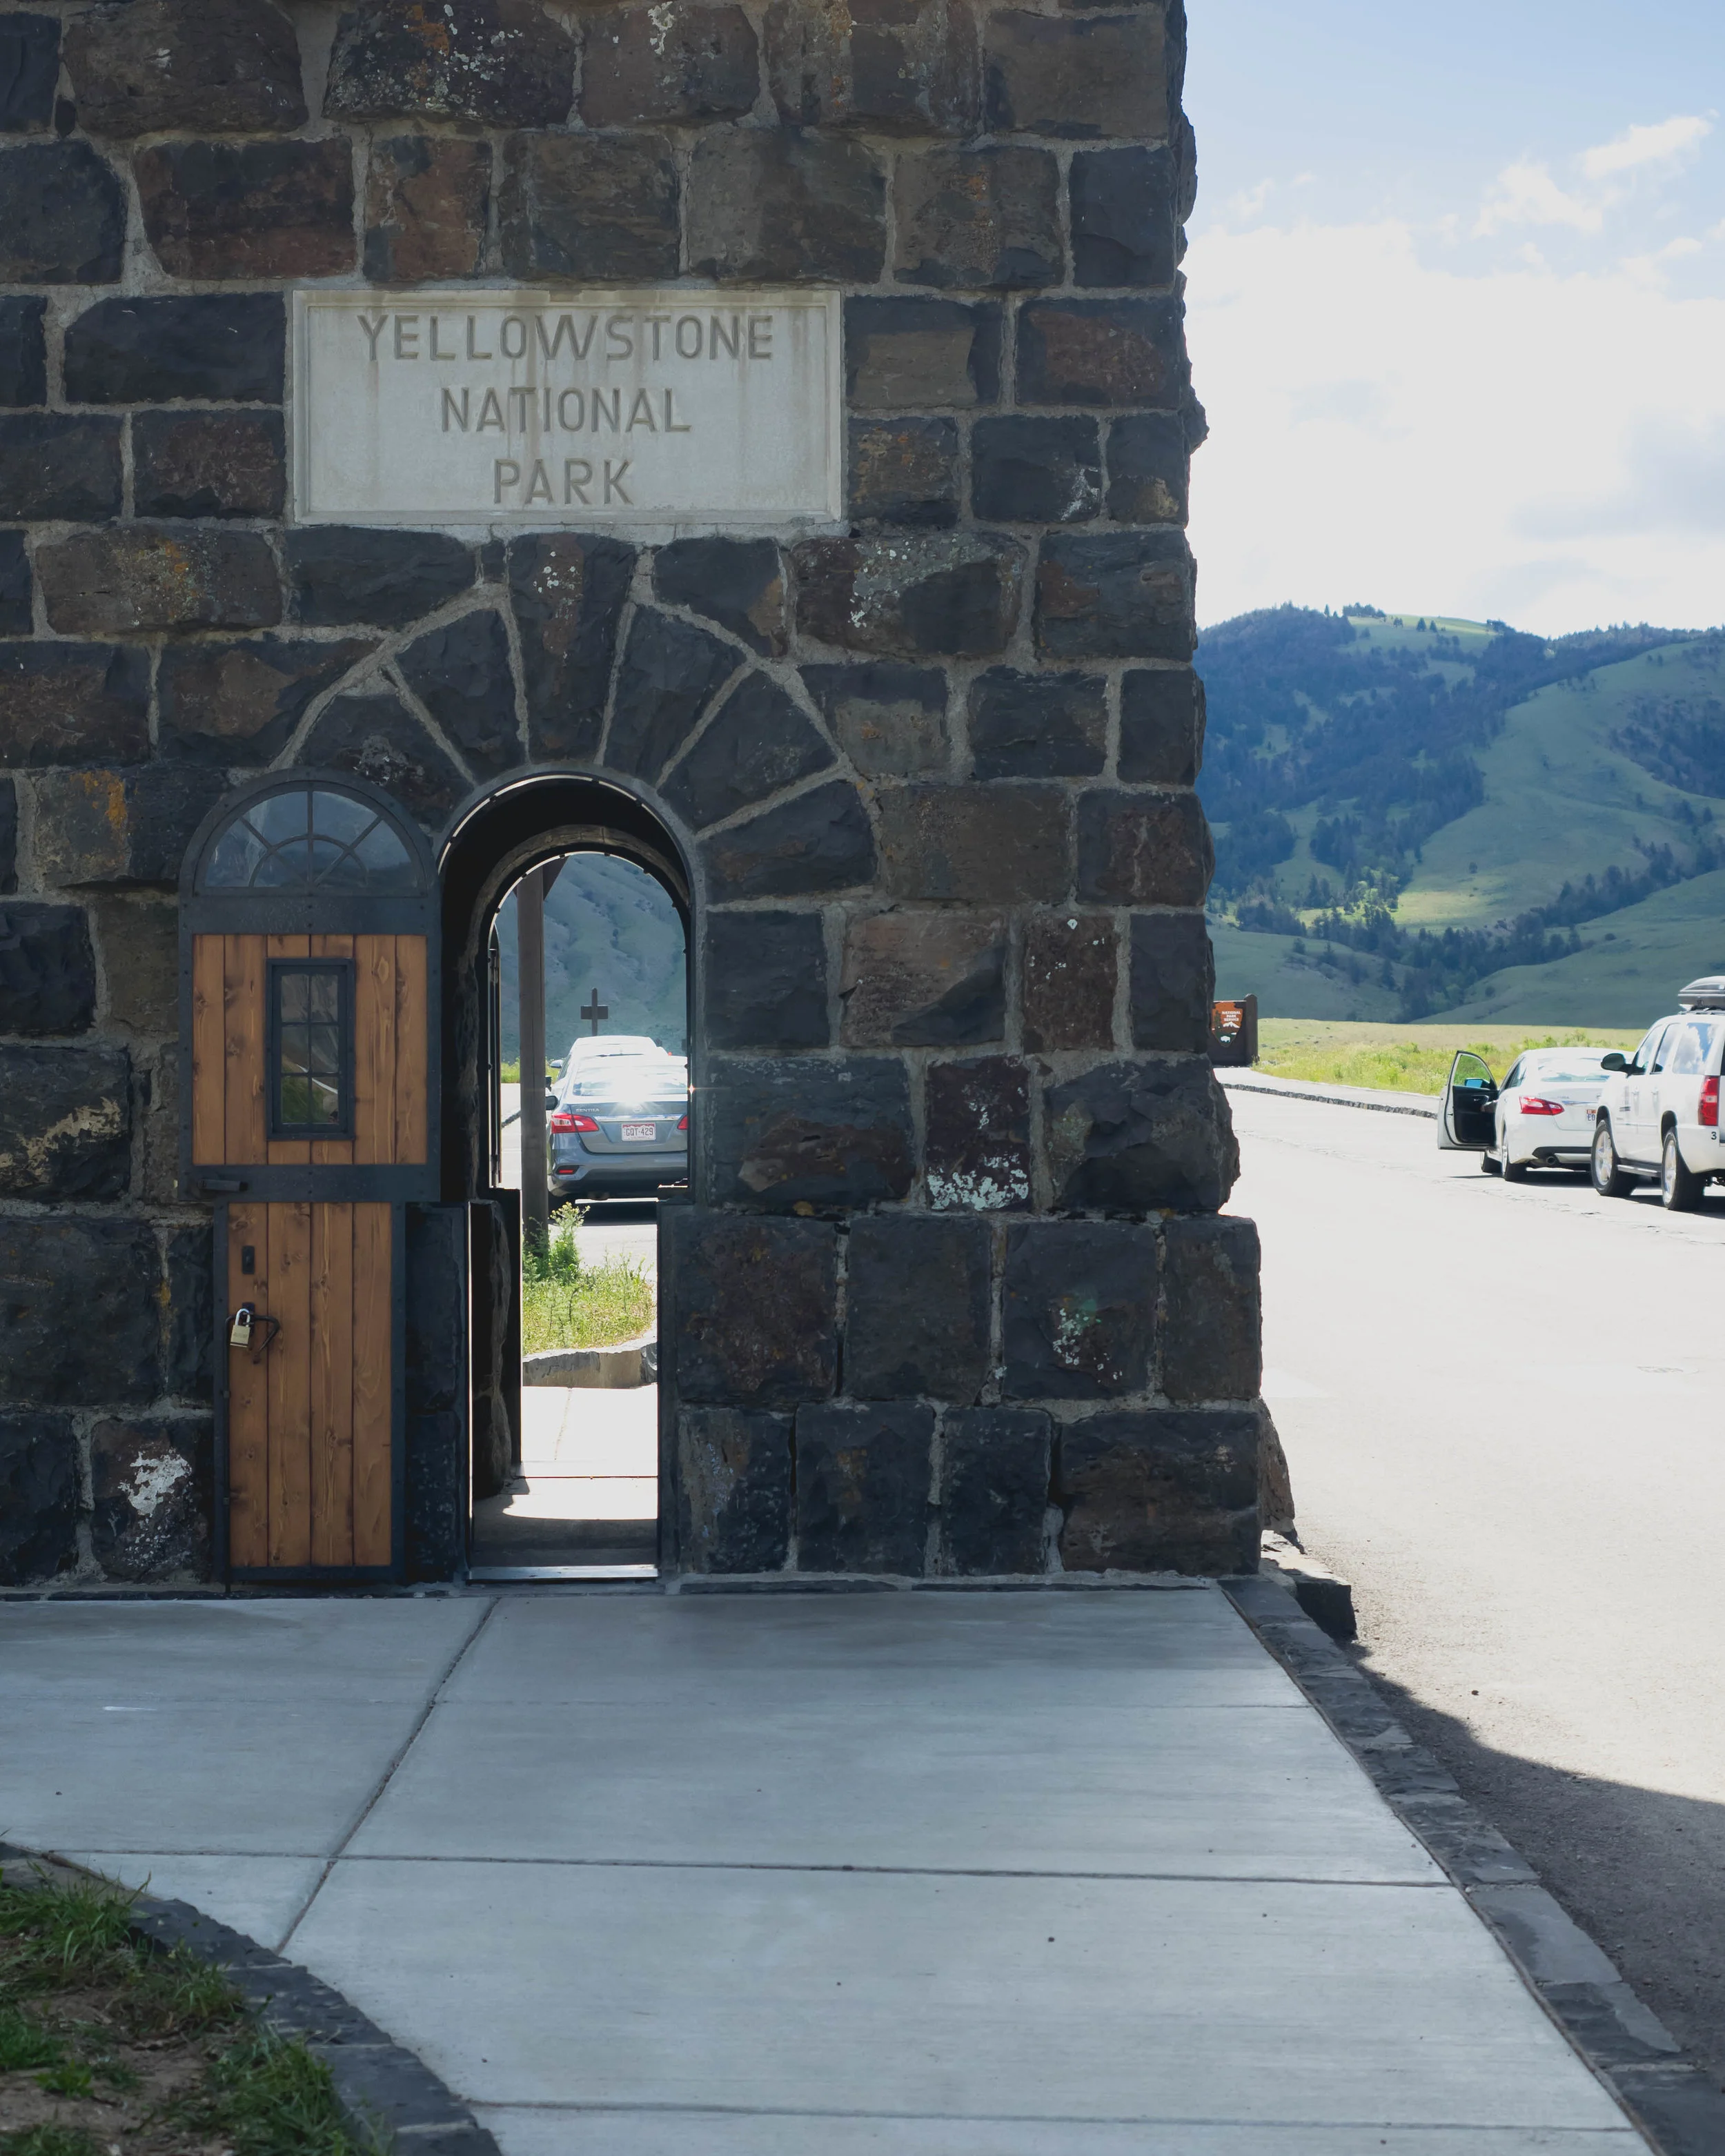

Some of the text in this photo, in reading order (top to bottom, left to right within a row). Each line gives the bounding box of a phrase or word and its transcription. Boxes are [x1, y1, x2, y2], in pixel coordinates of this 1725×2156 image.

[357, 315, 773, 361] YELLOWSTONE
[441, 386, 692, 433] NATIONAL
[493, 458, 633, 505] PARK
[1711, 1131, 1717, 1140] 3
